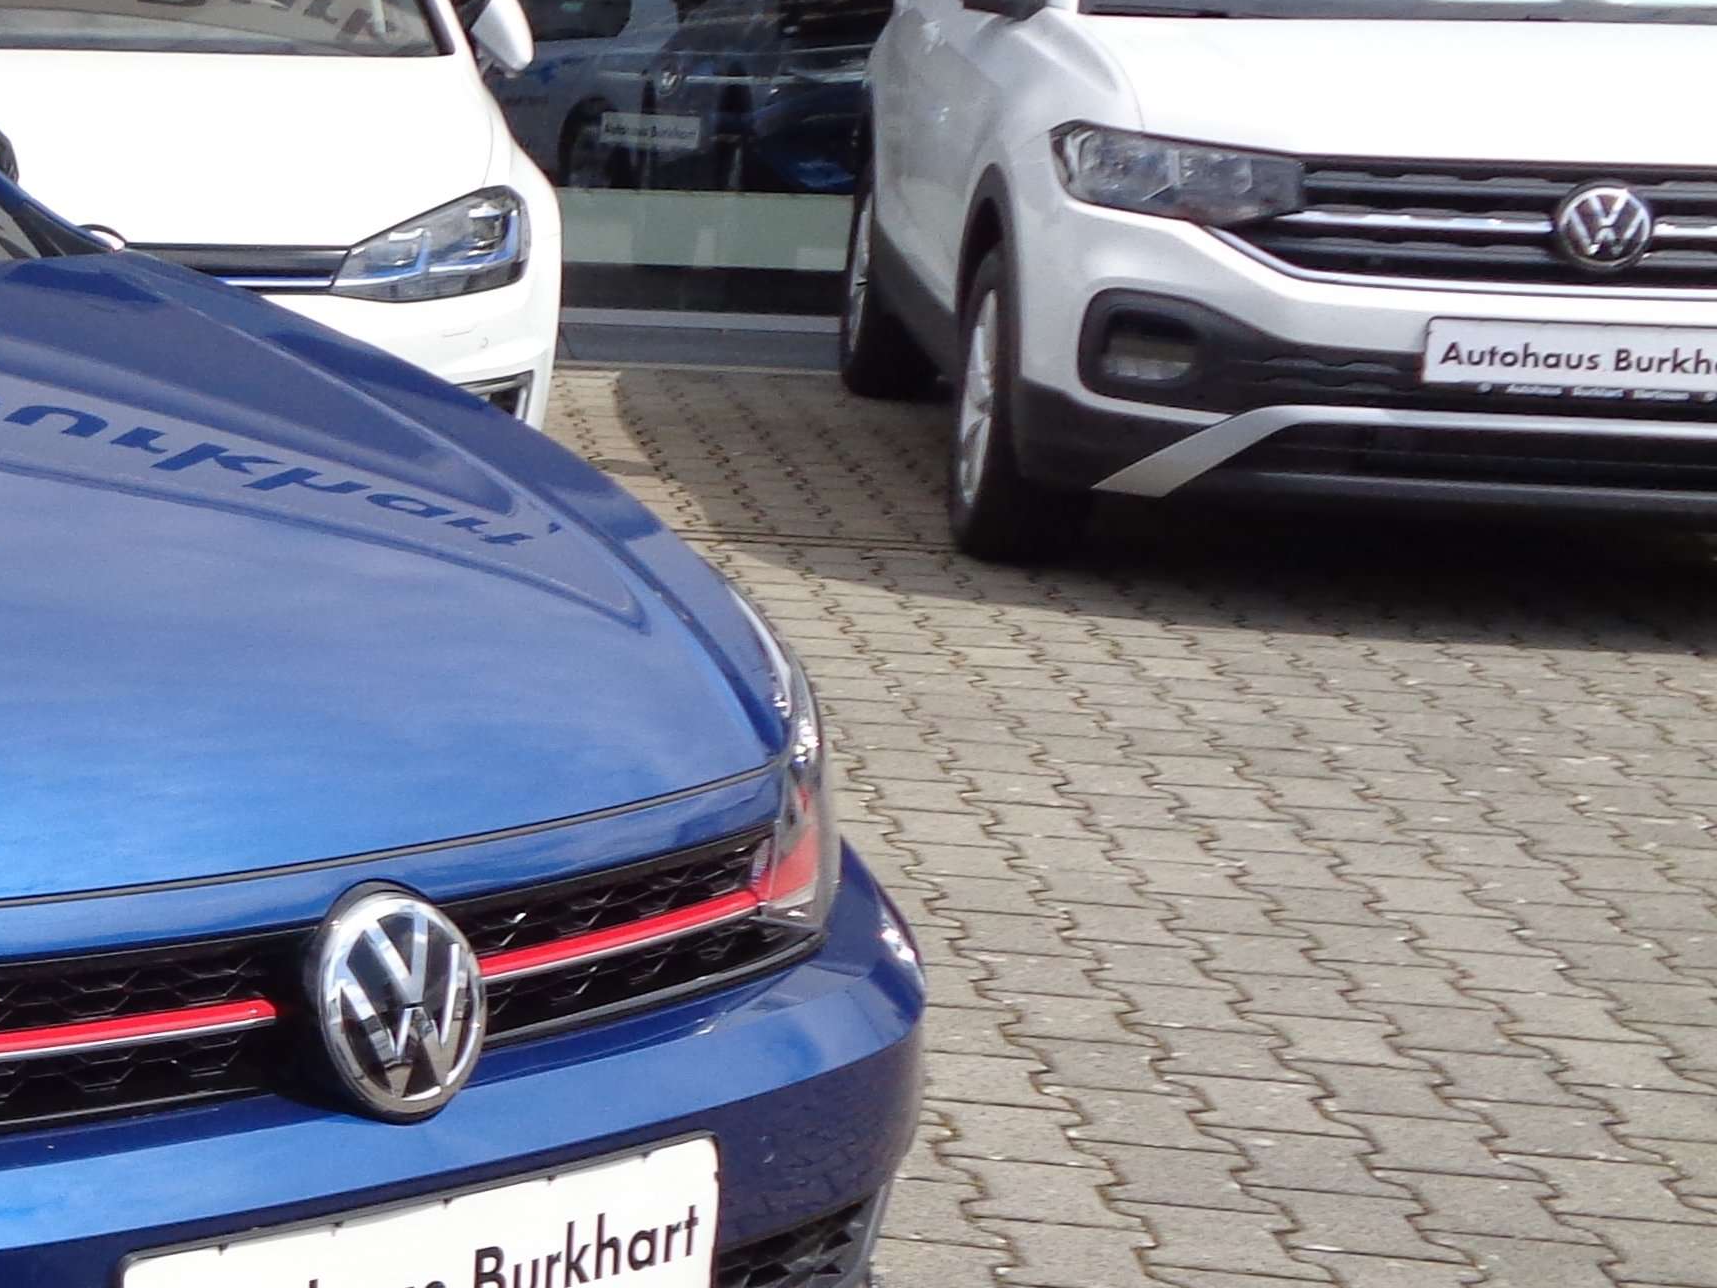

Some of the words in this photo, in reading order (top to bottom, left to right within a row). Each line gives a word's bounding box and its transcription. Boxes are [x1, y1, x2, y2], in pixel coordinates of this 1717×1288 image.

[1438, 341, 1601, 371] Autohaus
[1614, 347, 1717, 375] Burkh
[318, 888, 486, 1108] VW
